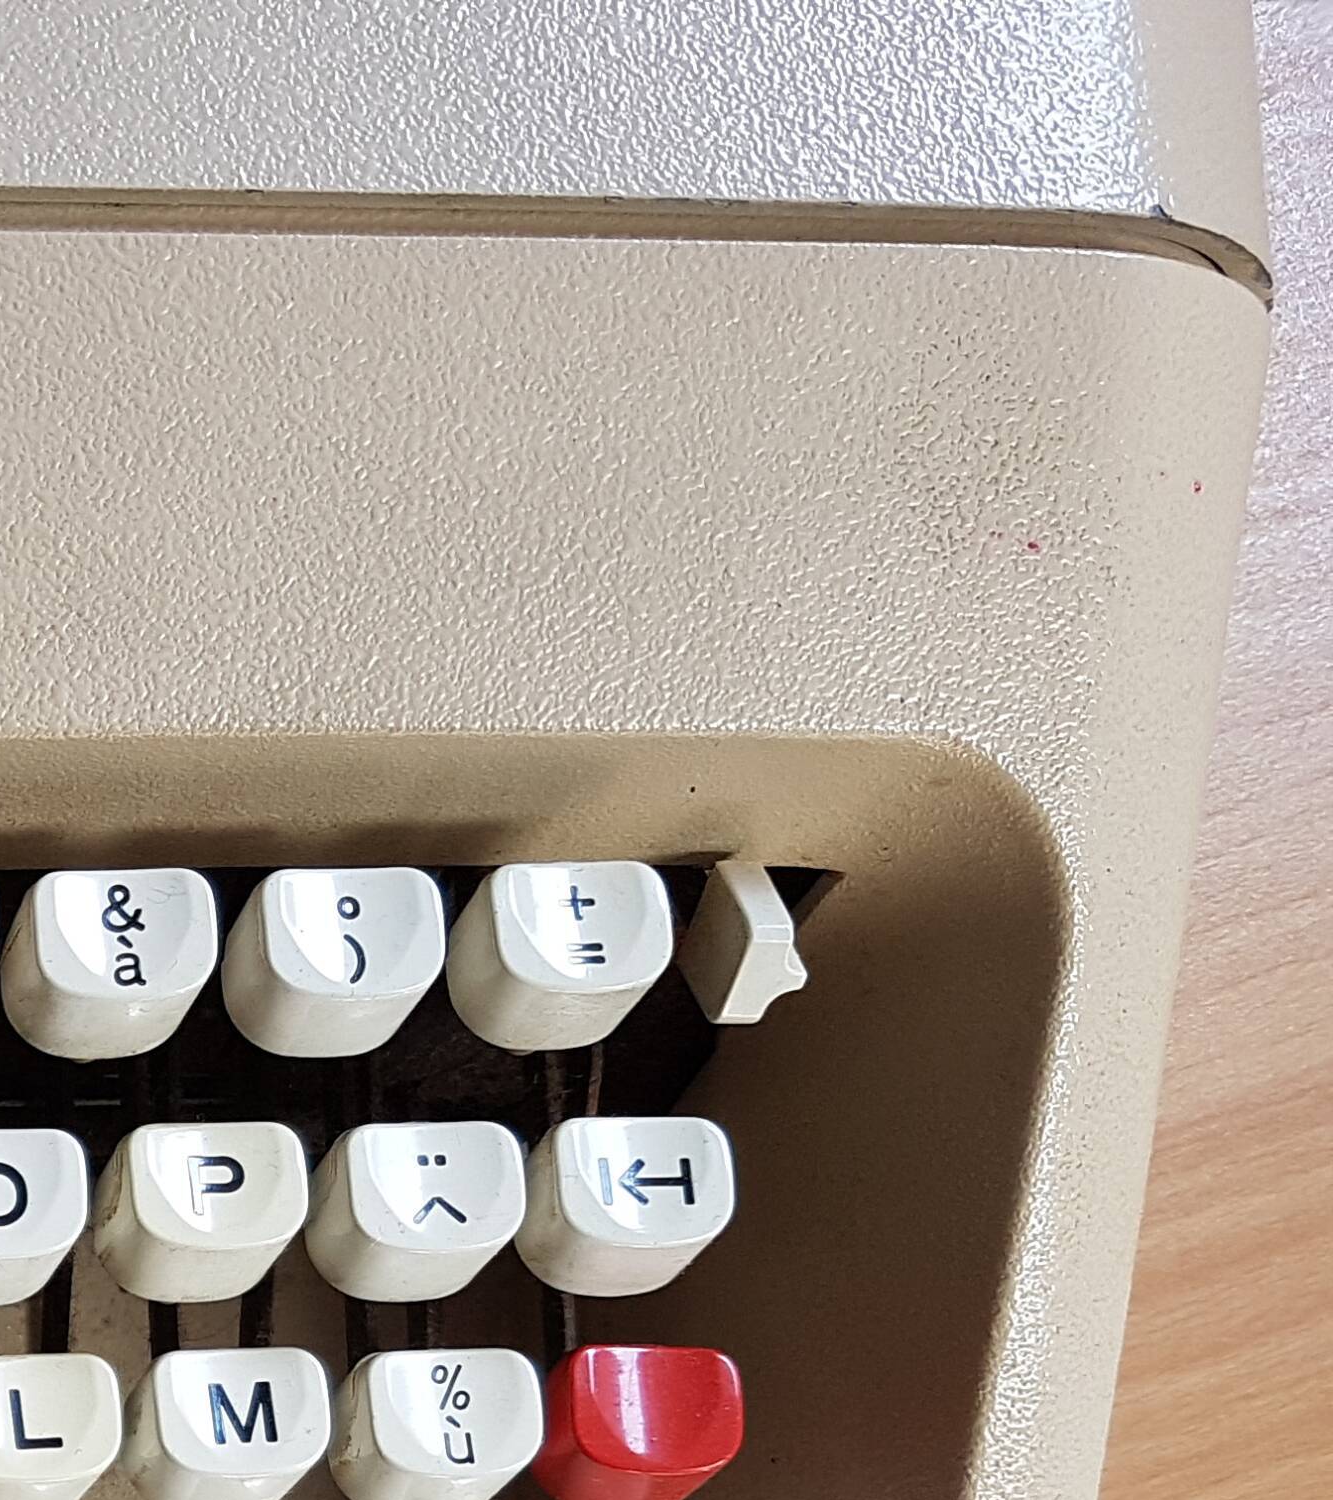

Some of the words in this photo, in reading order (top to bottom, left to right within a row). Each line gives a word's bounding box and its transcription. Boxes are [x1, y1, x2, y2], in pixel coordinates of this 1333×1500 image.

[101, 884, 146, 933] &
[559, 885, 596, 921] +
[113, 934, 147, 987] à
[343, 934, 367, 984] )
[567, 942, 607, 965] =
[186, 1155, 246, 1216] P
[431, 1364, 471, 1411] %
[9, 1389, 64, 1450] L
[208, 1381, 278, 1445] M
[443, 1415, 475, 1465] ù
